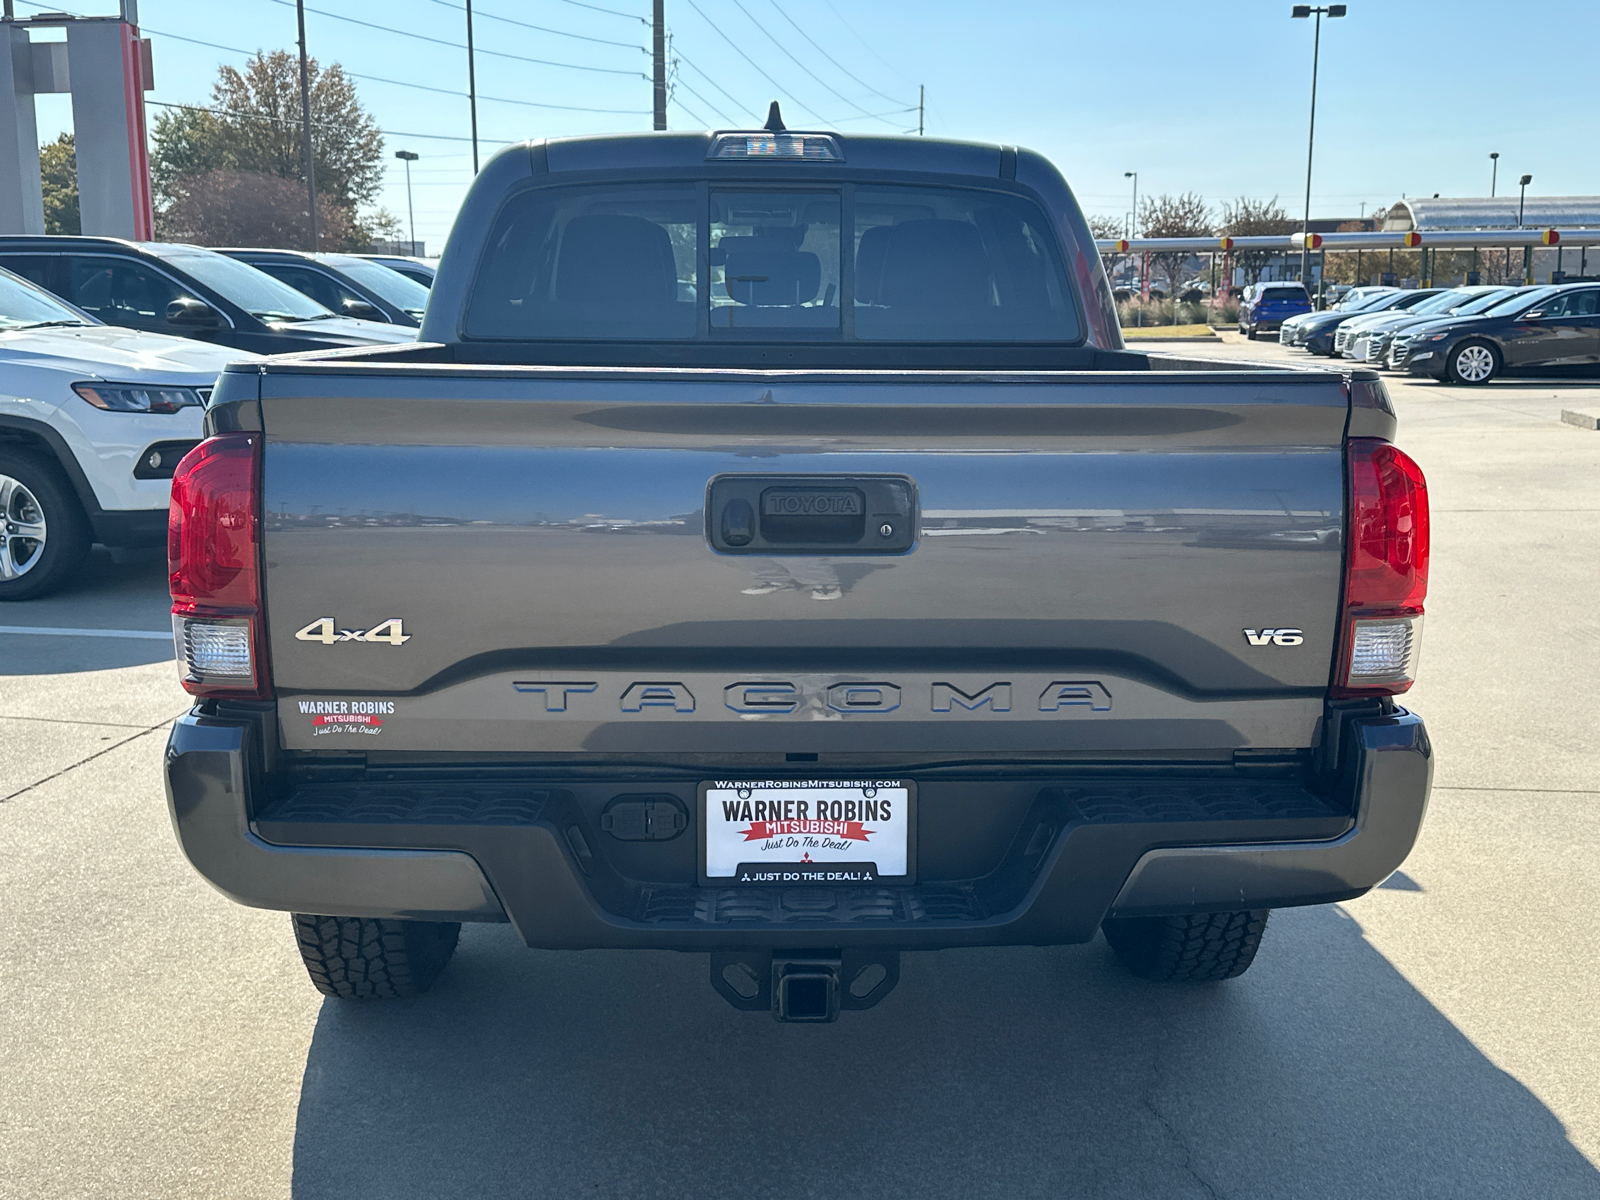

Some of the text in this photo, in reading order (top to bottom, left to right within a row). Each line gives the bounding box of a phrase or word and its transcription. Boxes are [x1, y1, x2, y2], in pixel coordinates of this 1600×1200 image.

[771, 495, 857, 513] TOYOTA
[294, 617, 412, 646] 4x4
[1242, 627, 1304, 646] V6
[512, 680, 1112, 713] TACOMA
[298, 701, 395, 714] WARNER ROBINS
[323, 715, 371, 723] MITSUBISHI
[313, 724, 382, 736] Just Do The Deal!
[722, 799, 892, 822] WARNER ROBINS
[765, 820, 848, 834] MITSUBISHI
[760, 836, 853, 851] Just Do The Deal!
[752, 872, 861, 881] JUST DO THE DEAL!
